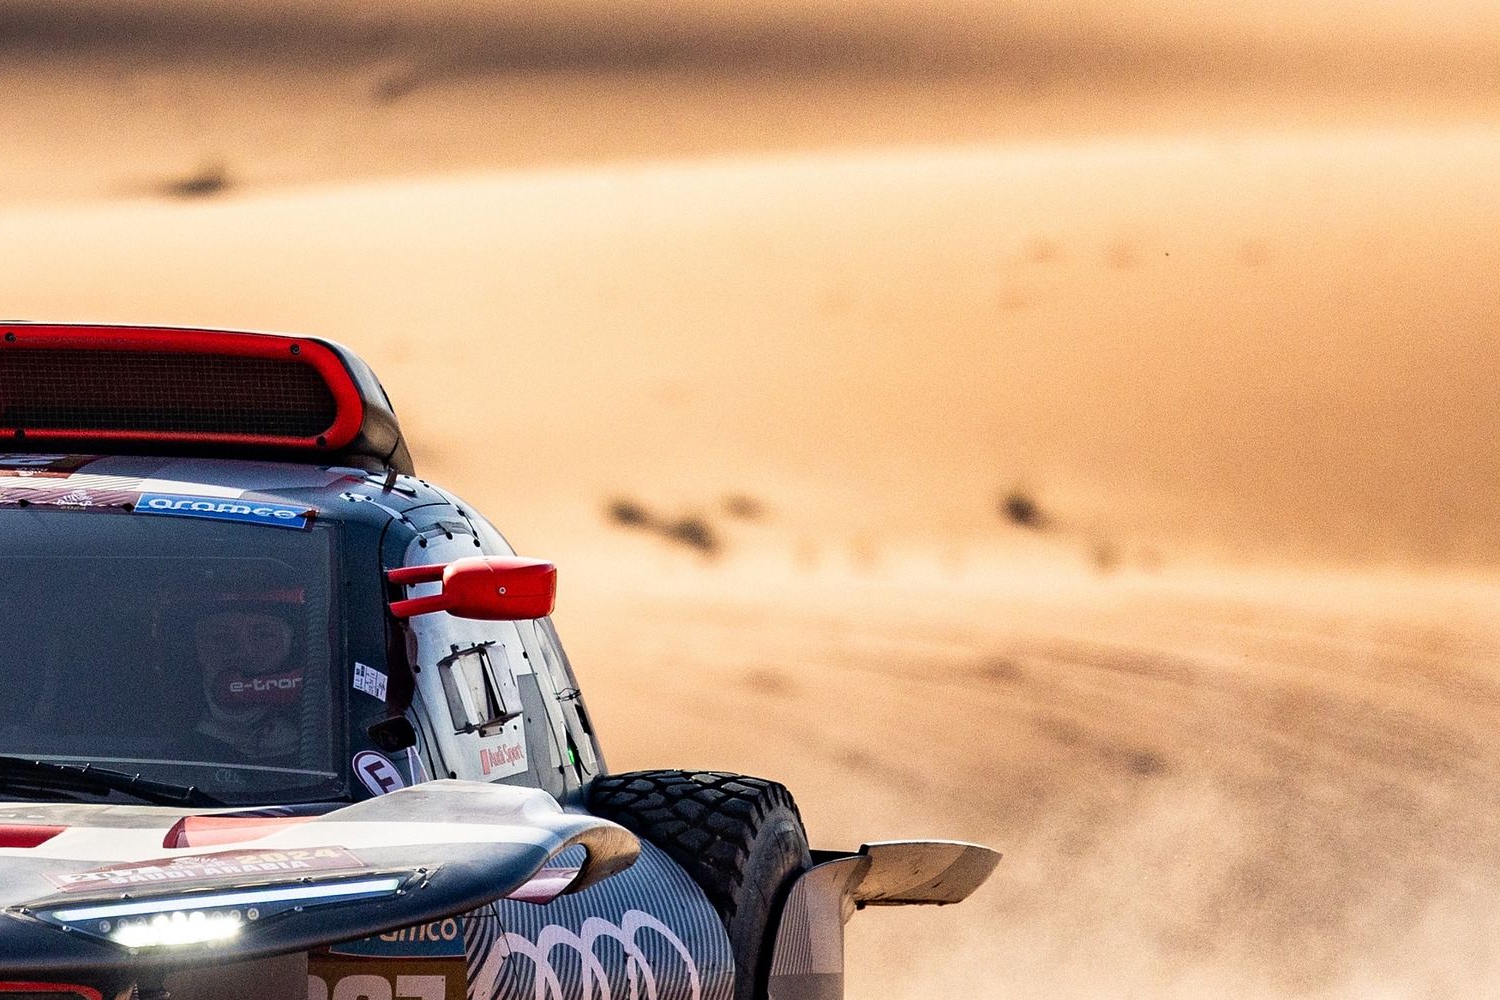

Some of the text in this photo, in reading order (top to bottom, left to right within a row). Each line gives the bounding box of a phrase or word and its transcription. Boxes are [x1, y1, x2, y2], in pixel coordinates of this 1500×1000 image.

[149, 498, 298, 519] aramco
[488, 743, 524, 767] Audi Sport
[235, 848, 342, 865] 2024
[107, 869, 197, 884] SAUDI
[203, 860, 311, 876] ARABIA
